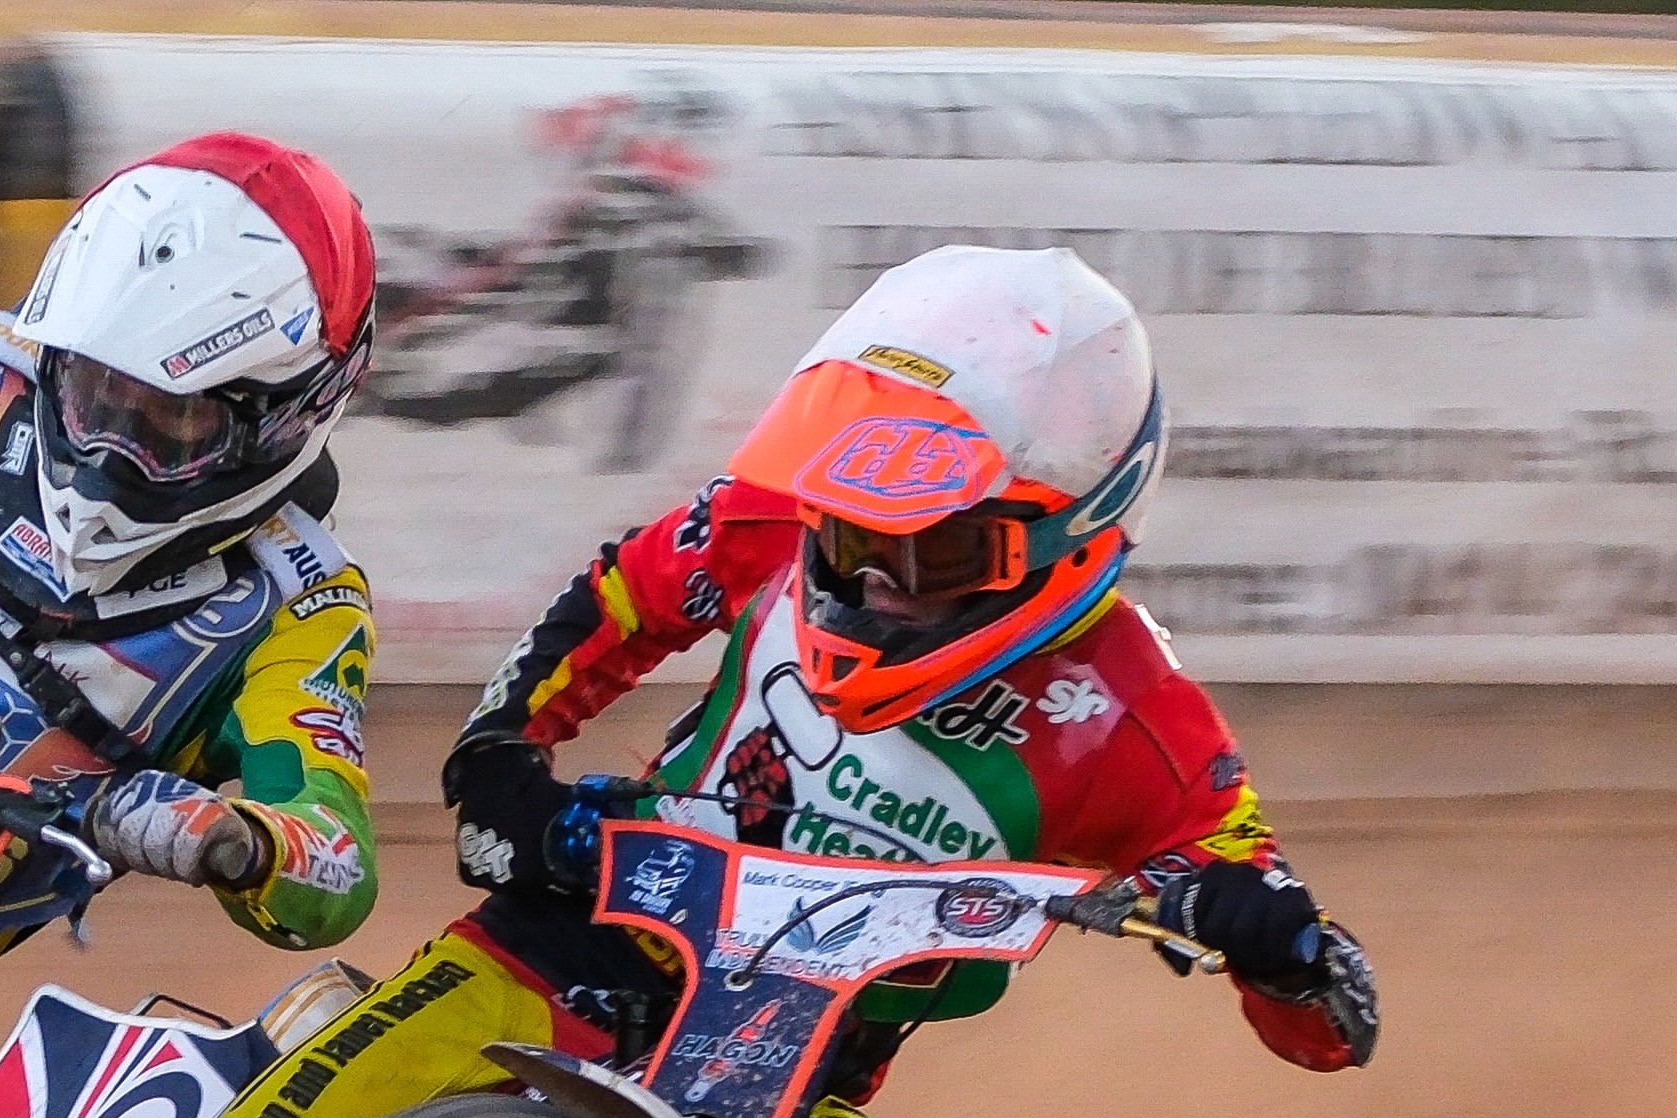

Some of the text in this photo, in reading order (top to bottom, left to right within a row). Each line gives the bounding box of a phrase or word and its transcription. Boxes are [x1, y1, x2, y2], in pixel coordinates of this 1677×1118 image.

[186, 311, 272, 366] MILLERS OILS
[827, 754, 997, 861] Cradley
[743, 869, 780, 888] Mark
[946, 897, 1006, 916] STS
[672, 1032, 800, 1067] HAGON
[277, 1057, 339, 1111] and
